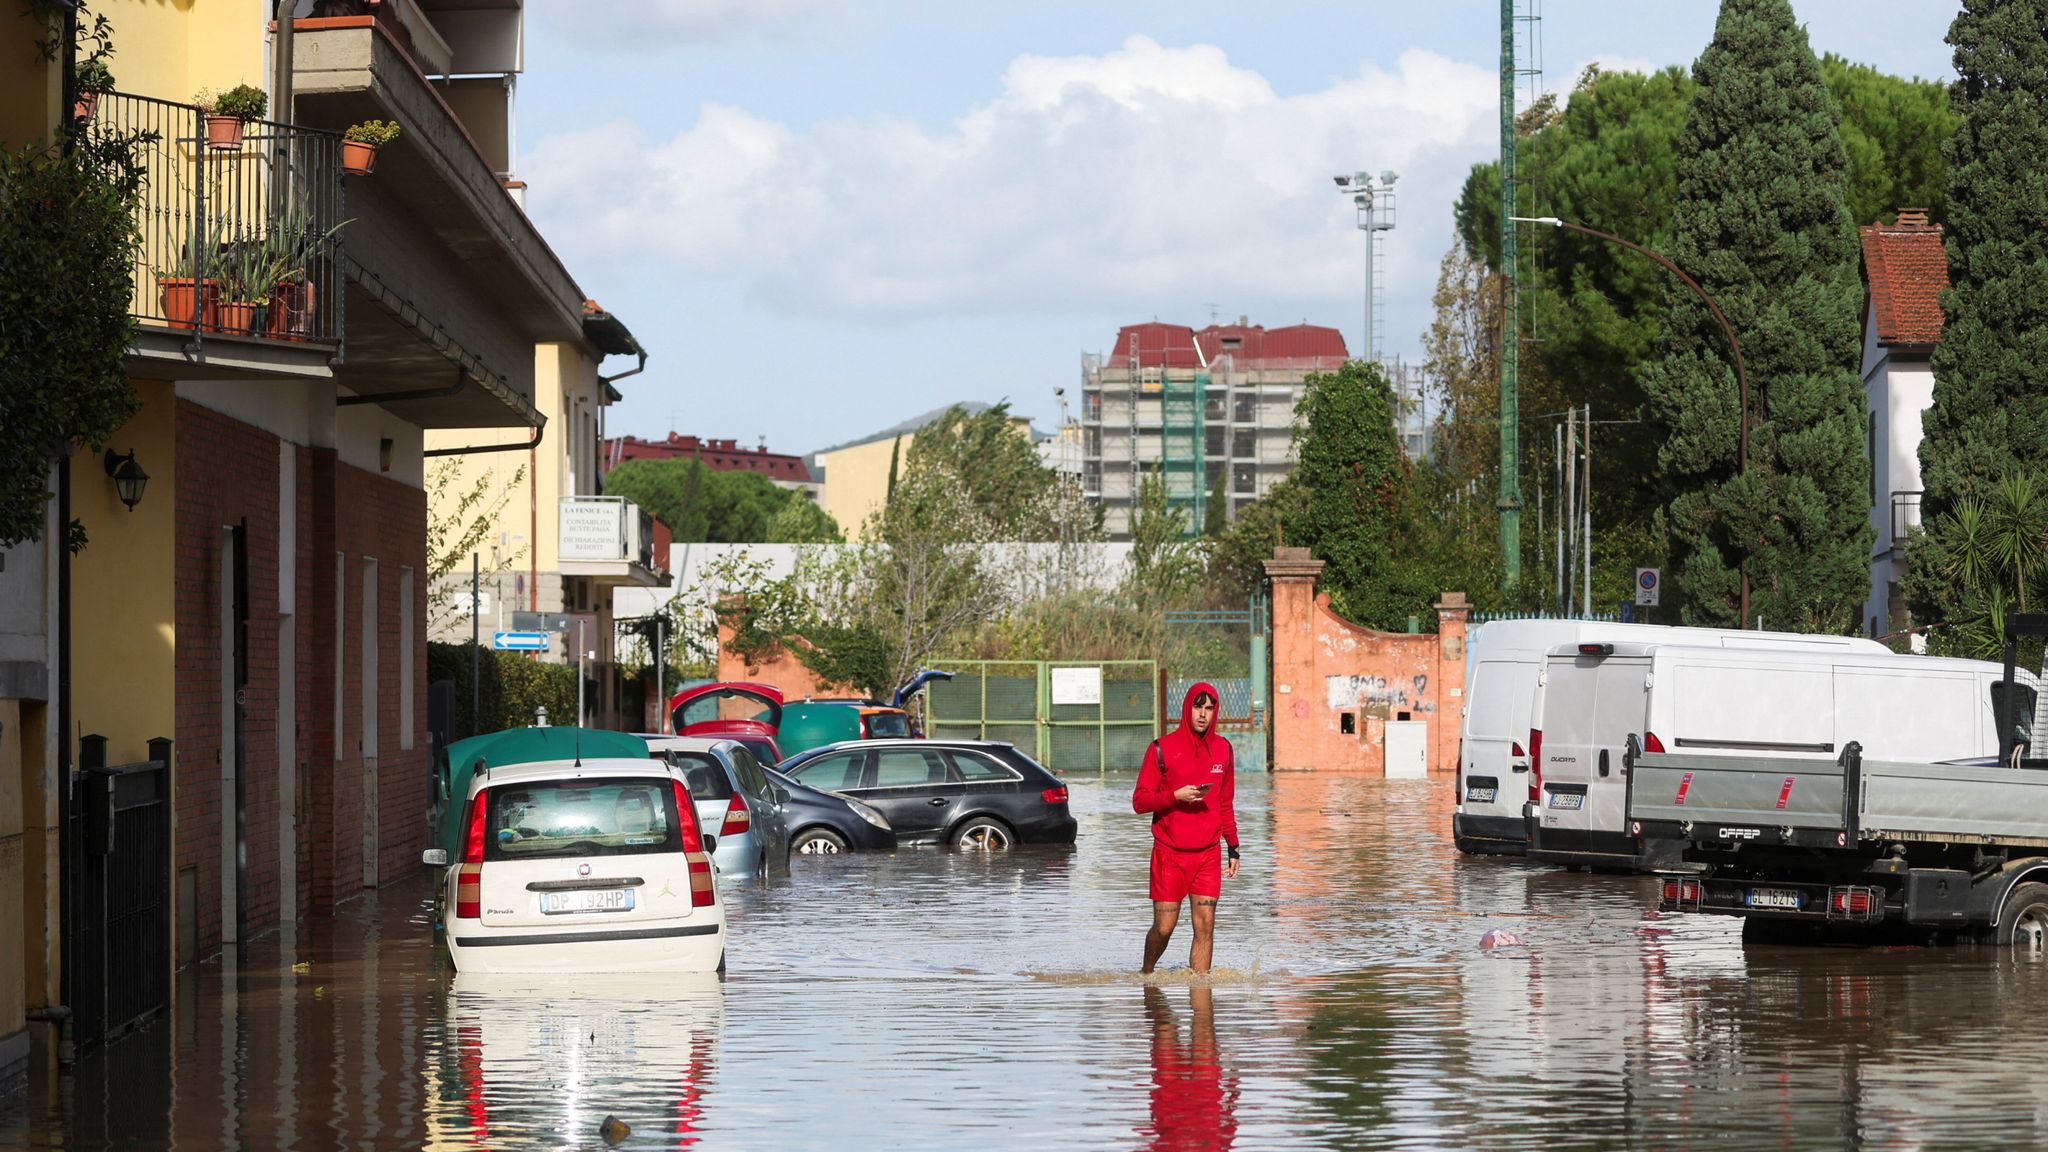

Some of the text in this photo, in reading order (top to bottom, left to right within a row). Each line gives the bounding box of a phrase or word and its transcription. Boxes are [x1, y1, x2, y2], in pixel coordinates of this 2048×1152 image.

[551, 894, 569, 909] DP
[1752, 889, 1797, 905] GL 162YS
